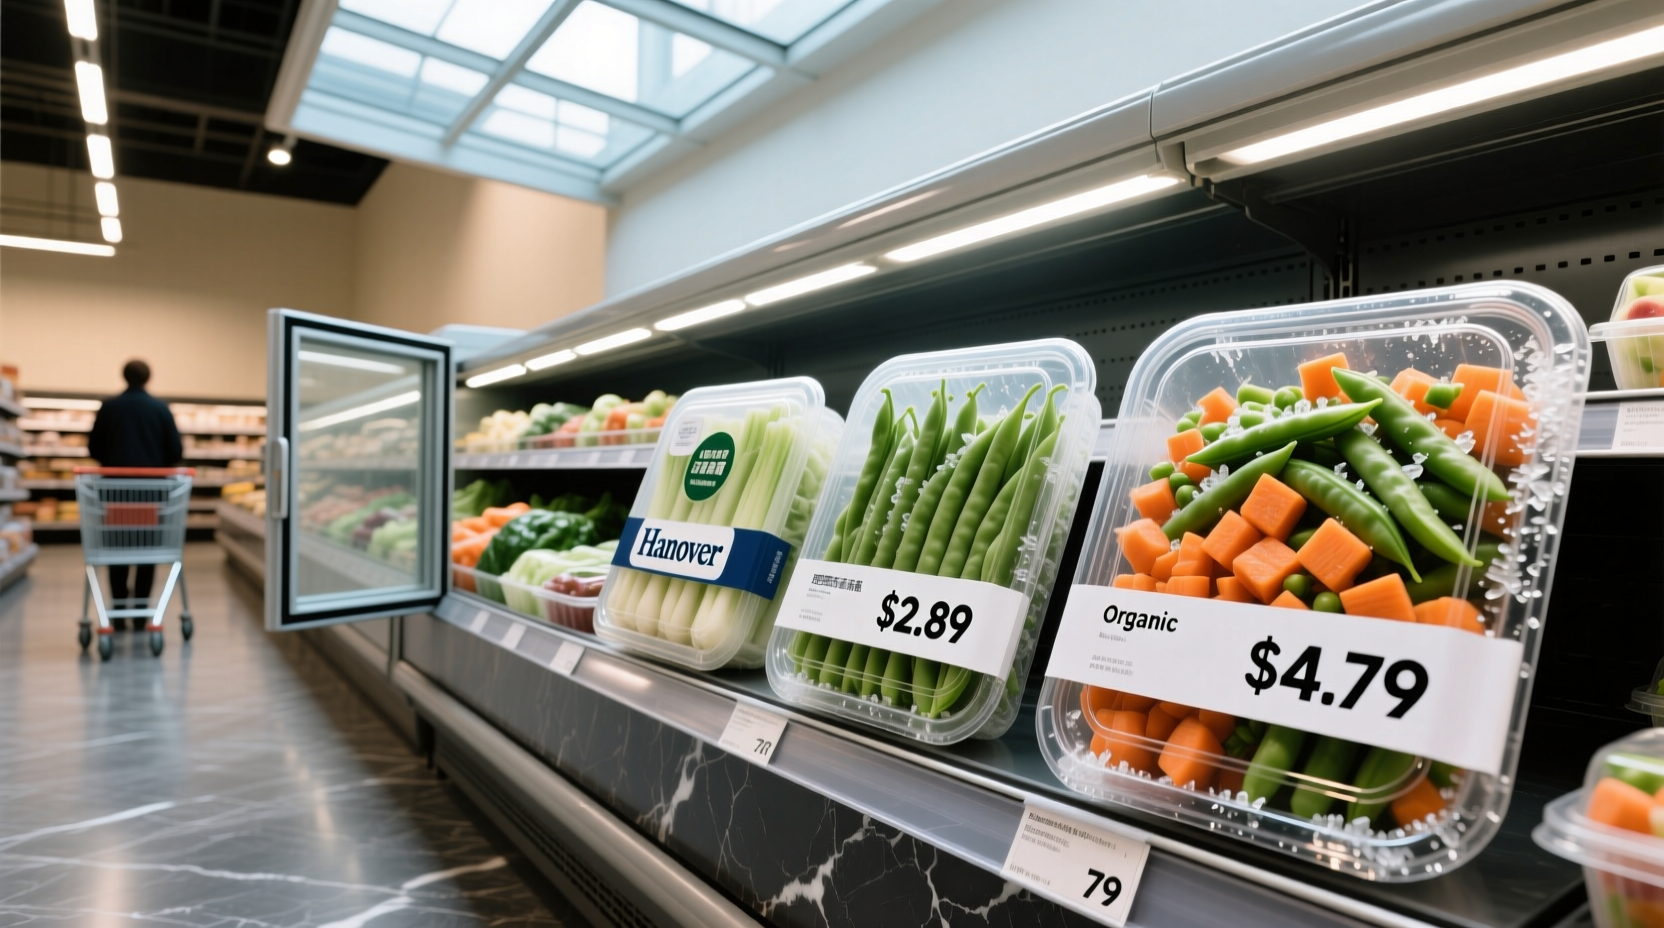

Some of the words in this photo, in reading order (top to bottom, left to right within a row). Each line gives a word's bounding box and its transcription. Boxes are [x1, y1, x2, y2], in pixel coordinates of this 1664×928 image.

[637, 527, 724, 567] Hanover
[876, 590, 973, 644] $2.89
[1103, 604, 1179, 633] Organic
[1245, 635, 1429, 719] $4.79
[1082, 868, 1122, 907] 79
